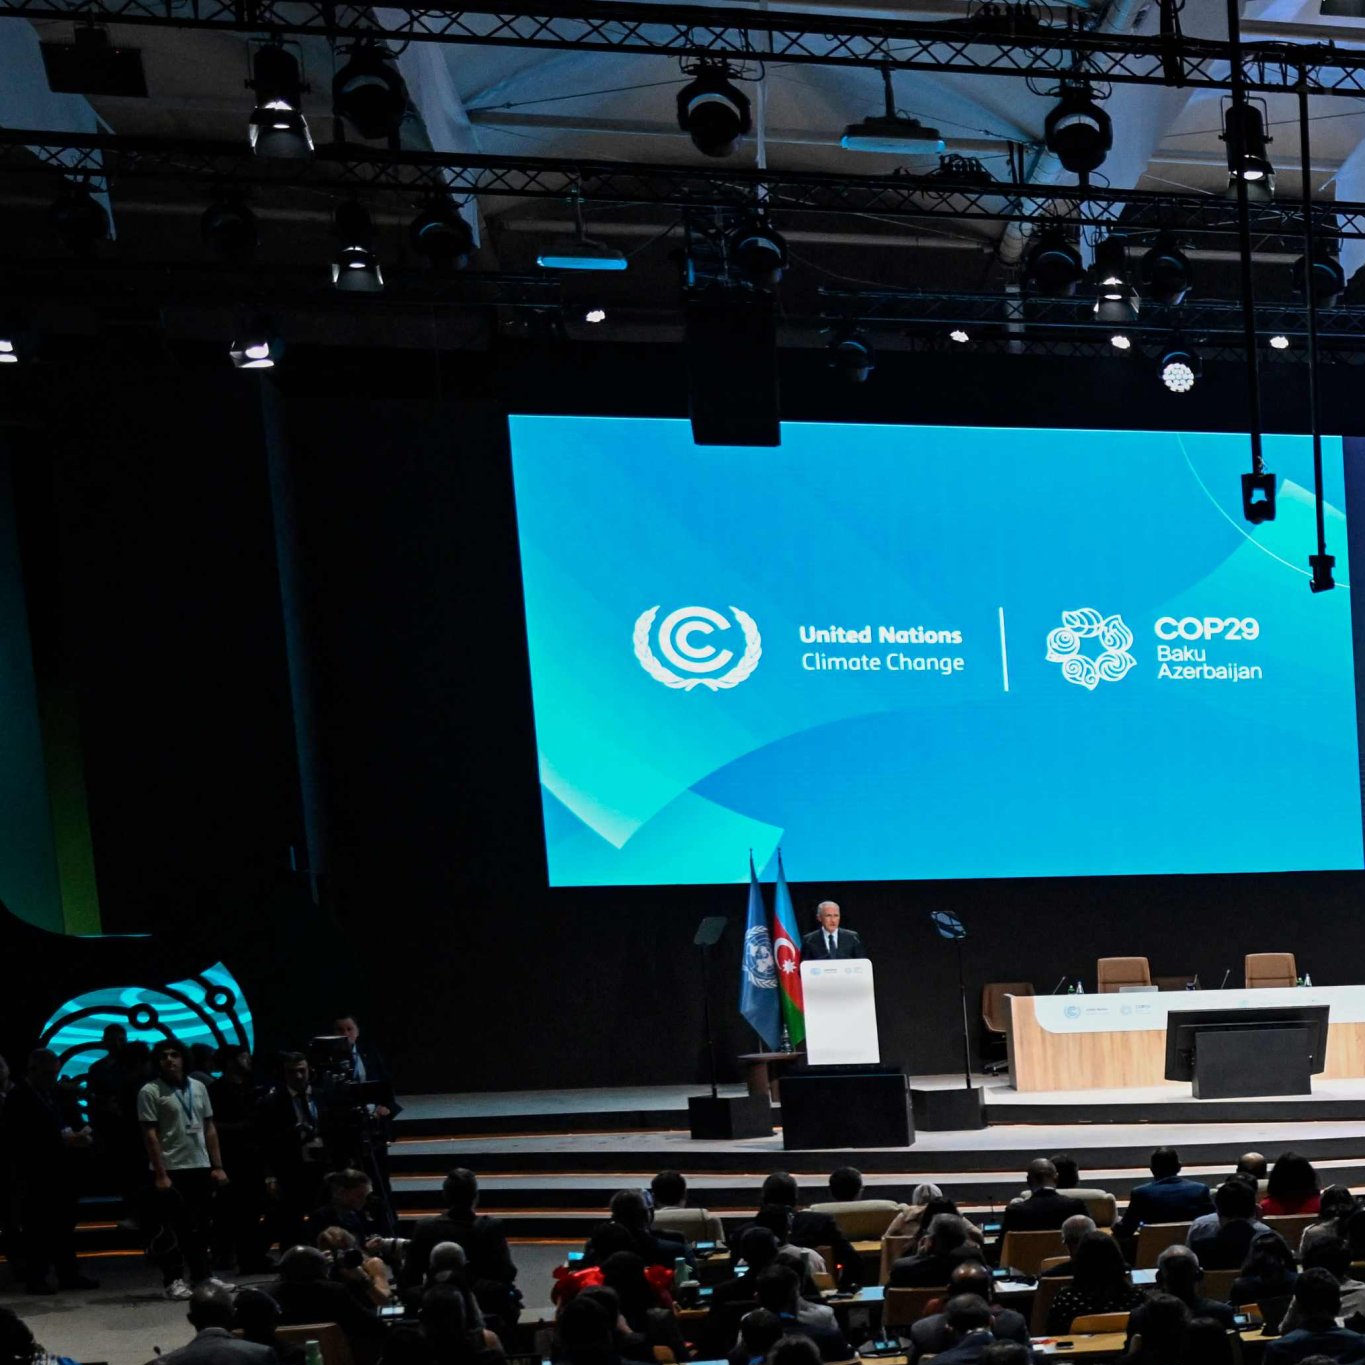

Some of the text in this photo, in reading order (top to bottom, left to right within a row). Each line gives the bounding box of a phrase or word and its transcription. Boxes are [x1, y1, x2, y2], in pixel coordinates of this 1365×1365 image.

[799, 625, 963, 644] United Nations
[1155, 616, 1260, 641] COP29
[1157, 644, 1207, 663] Baku
[802, 652, 965, 675] Climate Change
[1158, 663, 1263, 682] Azerbaijan
